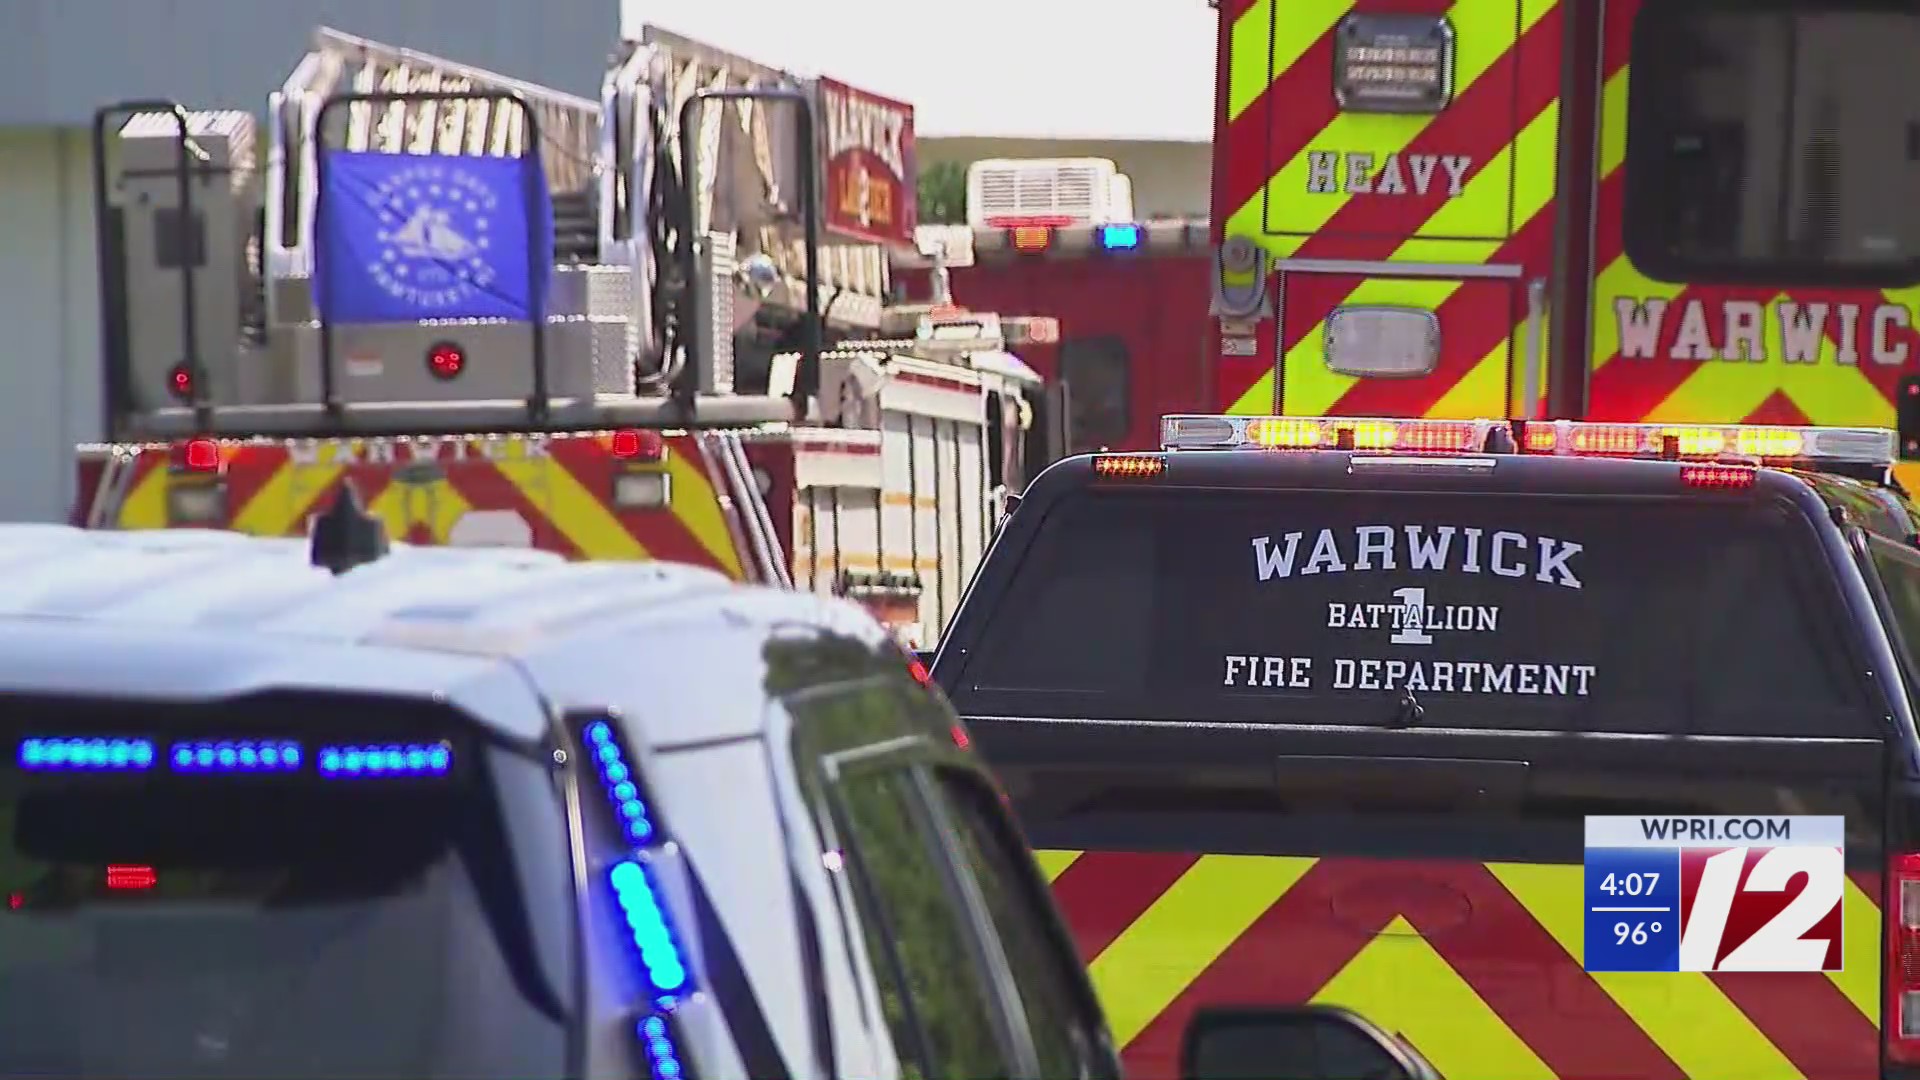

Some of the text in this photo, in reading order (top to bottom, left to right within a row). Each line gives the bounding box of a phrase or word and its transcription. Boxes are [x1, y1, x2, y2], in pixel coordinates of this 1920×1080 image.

[1307, 151, 1472, 196] HEAVY
[1615, 296, 1913, 365] WARWIC
[1252, 524, 1584, 589] WARWICK
[1327, 602, 1499, 632] BATTALION
[1390, 587, 1433, 645] 1
[1224, 655, 1596, 696] FIRE DEPARTMENT
